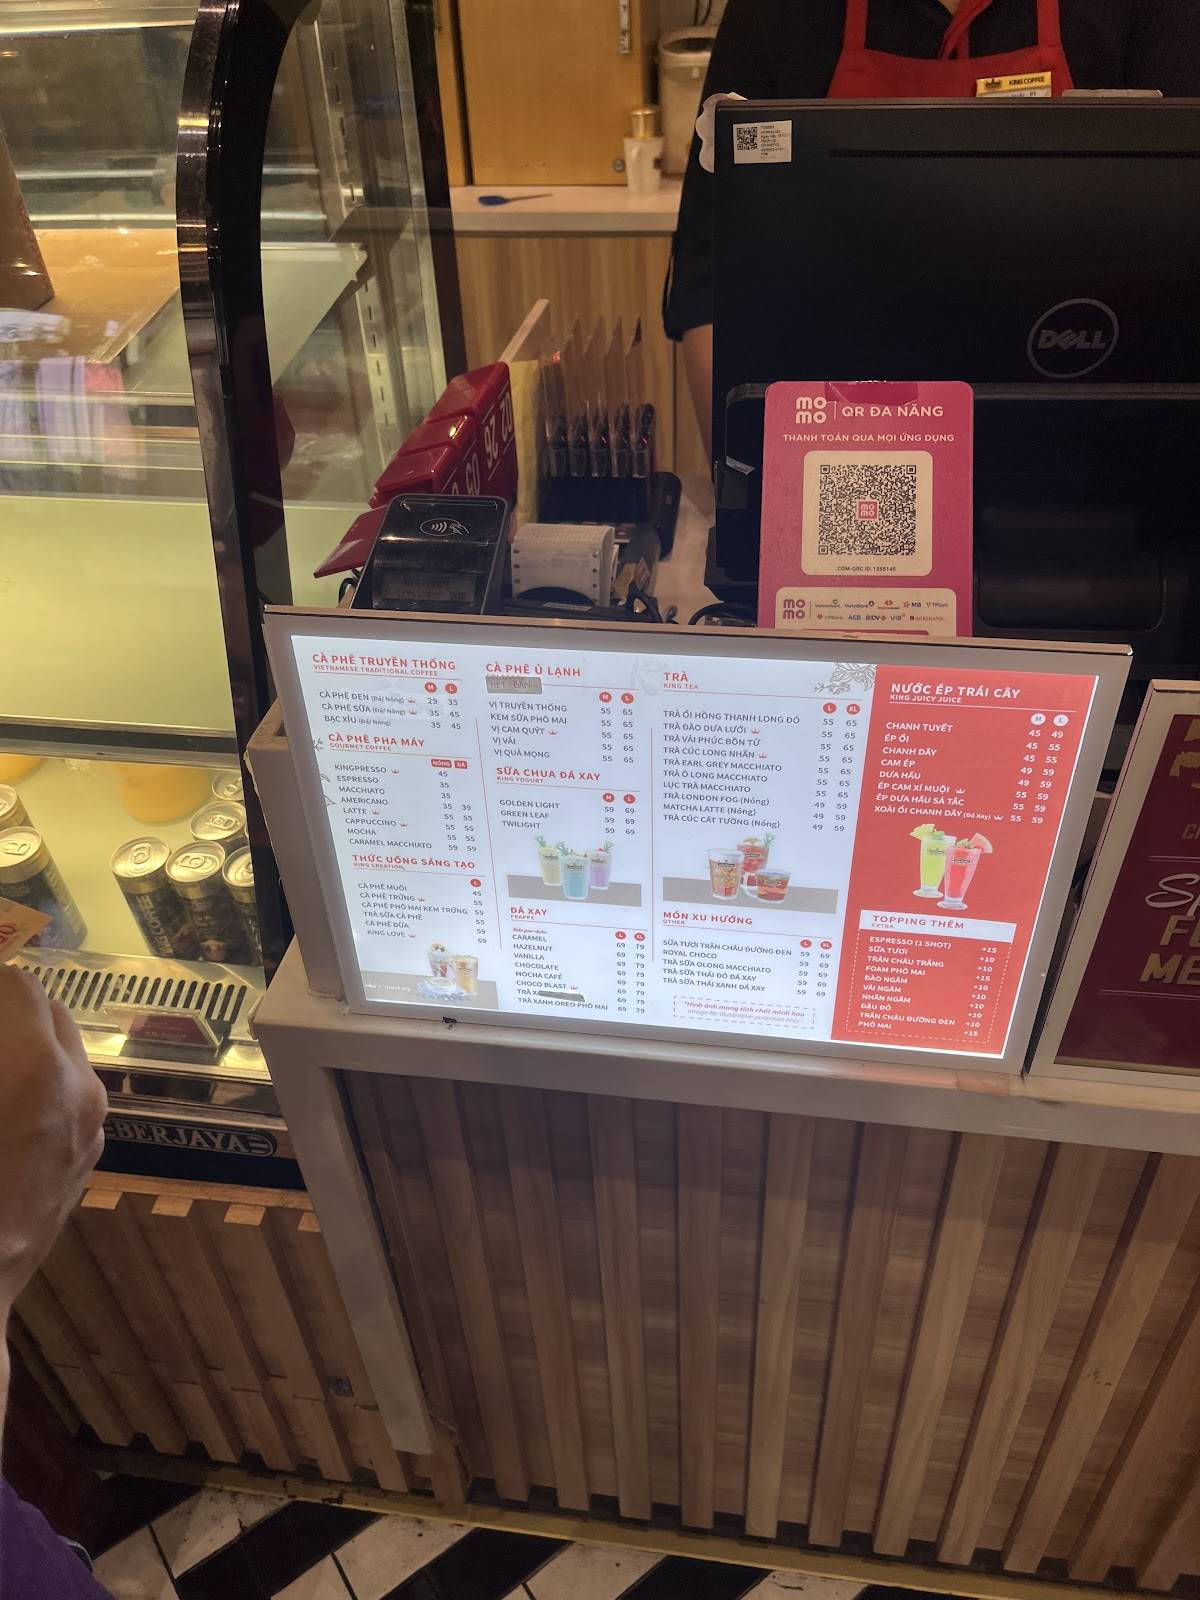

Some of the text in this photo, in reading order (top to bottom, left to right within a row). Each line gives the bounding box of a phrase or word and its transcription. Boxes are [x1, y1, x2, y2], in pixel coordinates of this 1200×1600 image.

[1038, 329, 1105, 350] DELL
[842, 402, 943, 417] QR ĐA NĂNG
[820, 432, 849, 442] TOÁN
[852, 434, 874, 442] QUA
[878, 434, 896, 443] MỌI
[900, 432, 922, 442] ỨNG
[925, 434, 954, 444] DỤNG
[312, 651, 456, 670] CÀ PHÊ TRUYỀN THỐNG
[314, 664, 358, 672] VIETNAMESE
[361, 667, 408, 675] TRADITIONAL
[486, 662, 500, 672] CÀ
[506, 663, 530, 674] PHÊ
[548, 667, 580, 678] LẠNH
[664, 671, 688, 681] TRÀ
[891, 681, 1021, 699] NƯỚC ÉP TRÁI CÂY
[489, 701, 497, 710] VỊ
[500, 701, 533, 710] TRUYỀN
[536, 703, 567, 712] THỐNG
[511, 713, 529, 722] SỮA
[530, 715, 550, 723] PHÔ
[552, 716, 567, 724] MAI
[886, 722, 1063, 739] CHANH TUYẾT 45 49
[329, 733, 424, 747] CÀ PHÊ PHA MÁY
[335, 764, 387, 773] KINGPRESSO
[731, 763, 782, 771] MACCHIATO
[881, 758, 1054, 776] CAM ÉP 49 59
[496, 766, 600, 781] SỮA CHUA ĐÁ XAY
[664, 769, 679, 777] TRÀ
[682, 769, 688, 777] Ô
[716, 774, 768, 782] MACCHIATO
[339, 786, 385, 794] MACCHIATO
[341, 797, 388, 805] AMERICANO
[536, 801, 560, 809] LIGHT
[501, 810, 528, 818] GREEN
[664, 803, 756, 816] MATCHA LATTE (Nóng)
[345, 818, 396, 827] CAPPUCCINO
[503, 820, 541, 829] TWILIGHT
[387, 841, 432, 849] MACCHIATO
[421, 857, 450, 867] SÁNG
[454, 860, 475, 870] TẠO
[510, 906, 547, 916] ĐÁ XAY
[663, 910, 753, 925] MÓN XU HƯỚNG
[873, 915, 965, 929] TOPPING THÊM
[513, 934, 547, 942] CARAMEL
[870, 936, 913, 945] ESPRESSO
[915, 938, 923, 947] (1
[925, 940, 951, 950] SHOT)
[865, 965, 890, 973] FOAM
[115, 1121, 250, 1152] BERJAYA
